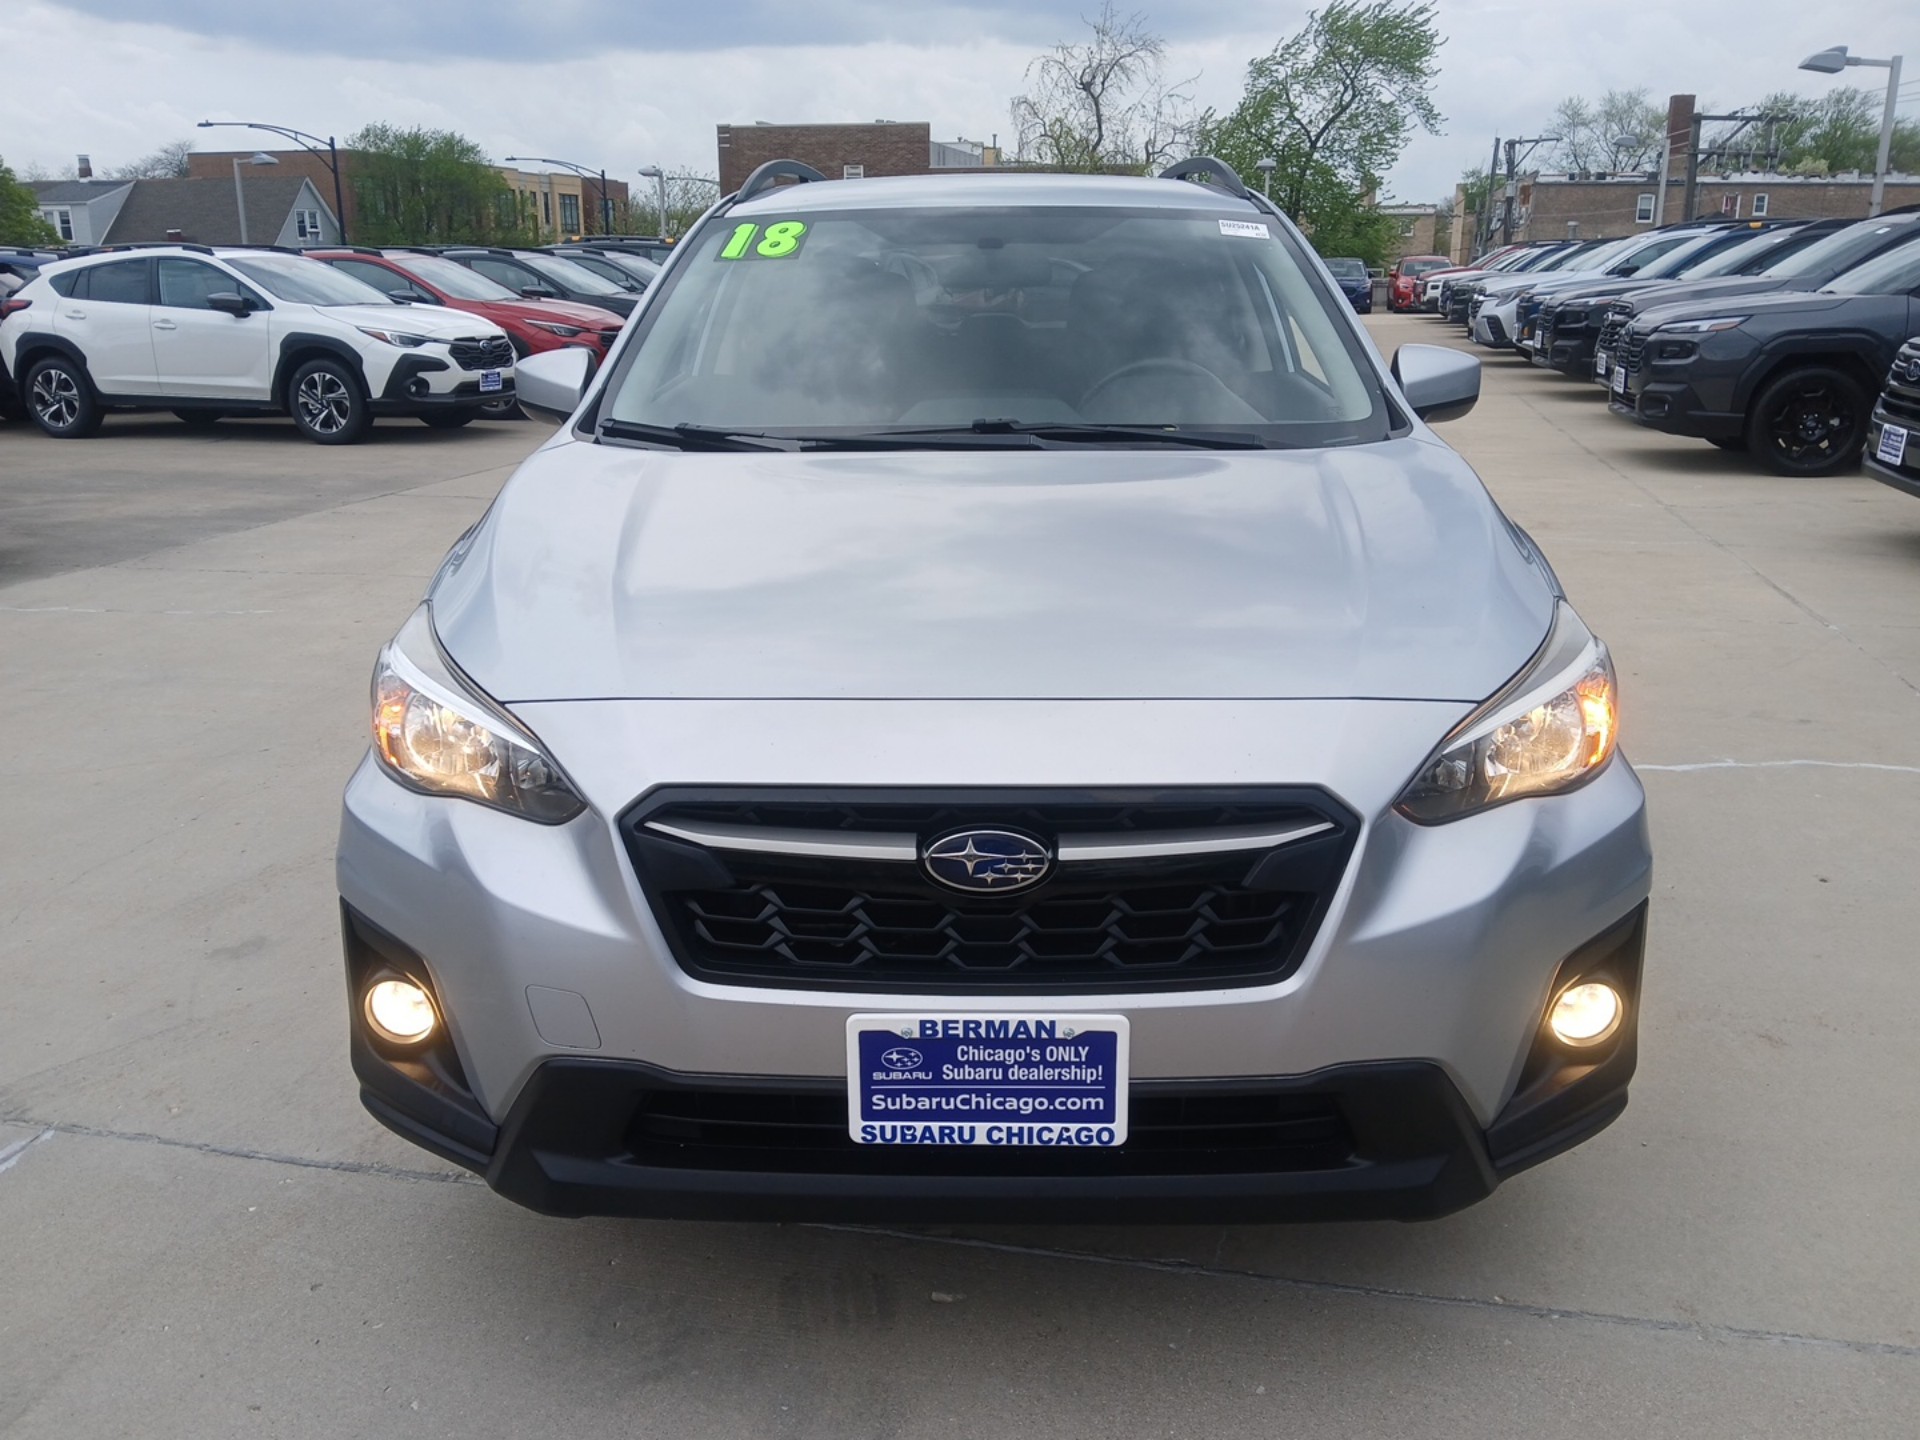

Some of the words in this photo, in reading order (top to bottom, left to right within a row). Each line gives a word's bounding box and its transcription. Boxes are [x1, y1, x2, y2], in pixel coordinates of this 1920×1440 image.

[720, 220, 807, 259] 18
[919, 1020, 1057, 1038] BERMAN
[957, 1046, 1040, 1063] Chicago's
[1046, 1046, 1089, 1062] ONLY
[872, 1071, 932, 1080] SUBARU
[942, 1065, 1002, 1081] Subaru
[1008, 1065, 1103, 1083] dealership!
[871, 1093, 1104, 1114] SubaruChicago.com
[860, 1125, 976, 1145] SUBARU
[986, 1126, 1116, 1145] CHICAGO
